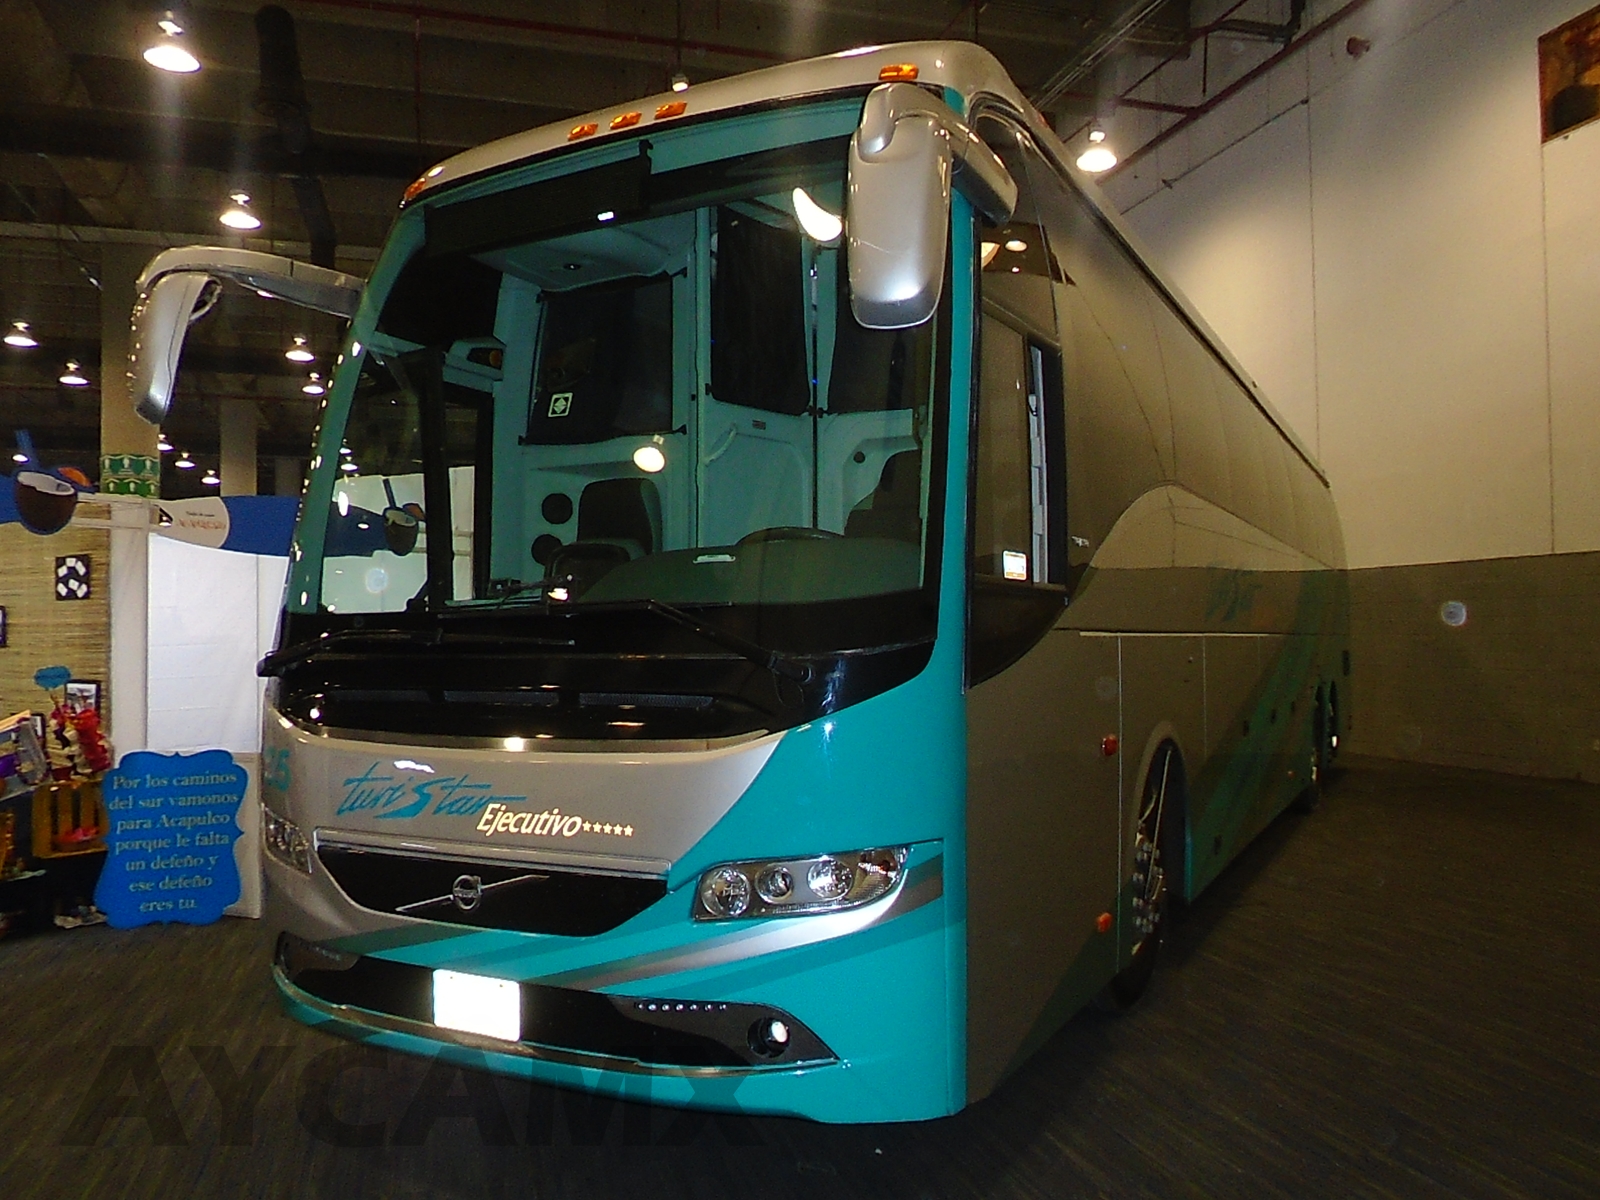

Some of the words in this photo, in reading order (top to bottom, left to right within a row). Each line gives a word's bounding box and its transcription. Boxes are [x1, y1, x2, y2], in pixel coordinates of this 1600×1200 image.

[112, 774, 141, 790] Por
[145, 774, 168, 788] los
[172, 770, 237, 786] caminos
[108, 795, 134, 810] del
[138, 799, 163, 808] sur
[168, 793, 239, 807] vamonos
[116, 818, 152, 835] para
[156, 811, 231, 830] Acapulco
[476, 803, 584, 837] Ejecutivo
[115, 837, 171, 855] porque
[176, 833, 190, 848] le
[195, 831, 230, 846] falta
[125, 859, 146, 871] un
[150, 853, 204, 869] defeño
[207, 855, 219, 870] y
[129, 881, 154, 892] ese
[158, 875, 213, 890] defeño
[139, 900, 173, 912] eres
